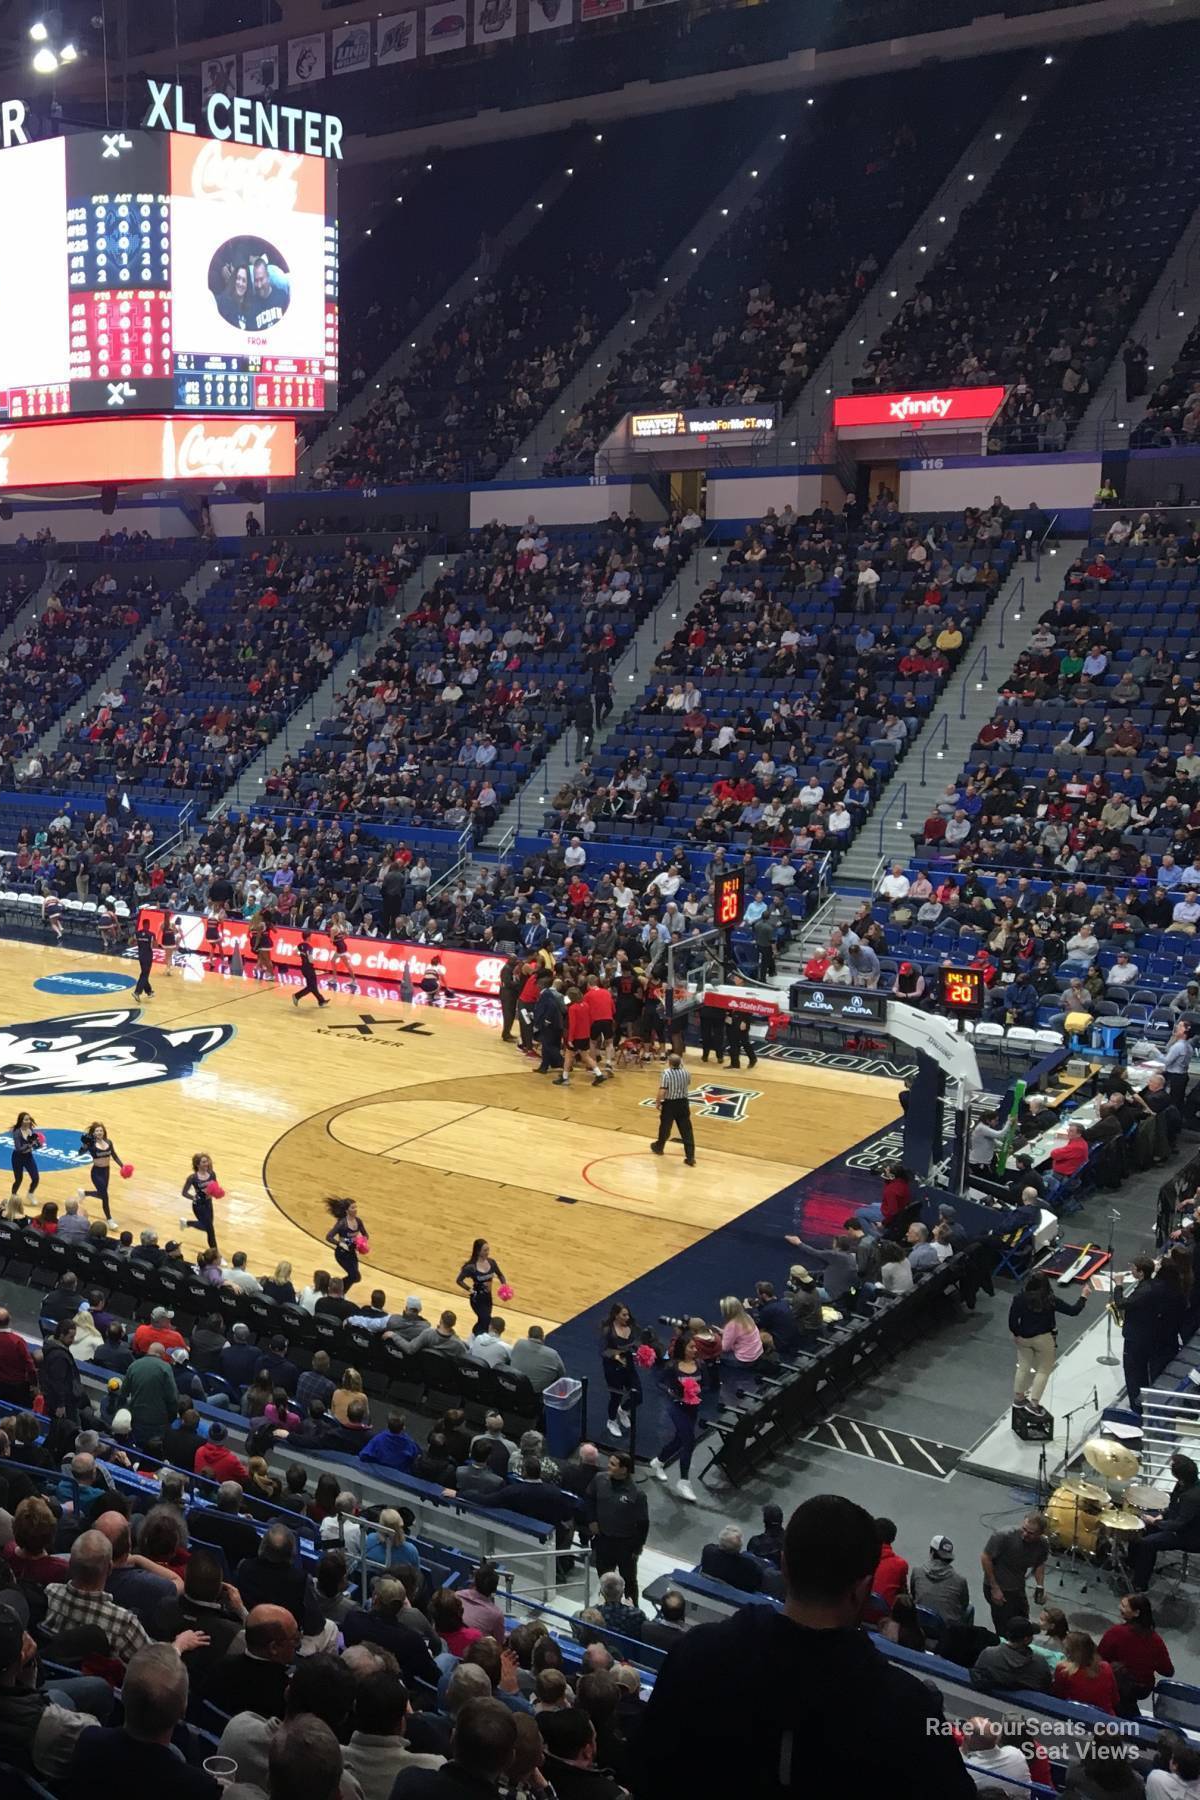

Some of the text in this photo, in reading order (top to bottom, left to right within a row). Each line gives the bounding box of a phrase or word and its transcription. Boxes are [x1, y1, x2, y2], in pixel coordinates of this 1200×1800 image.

[147, 80, 344, 159] XL CENTER
[102, 133, 132, 158] XL
[92, 194, 109, 204] PTS
[114, 193, 132, 203] AST
[95, 206, 106, 218] 0
[118, 205, 129, 217] 0
[140, 204, 150, 217] 0
[160, 205, 169, 217] 0
[118, 220, 129, 233] 0
[140, 220, 151, 232] 0
[160, 221, 169, 233] 0
[96, 238, 107, 250] 0
[118, 236, 129, 249] 0
[160, 237, 169, 249] 0
[96, 253, 107, 266] 0
[161, 253, 169, 265] 0
[119, 268, 130, 281] 0
[141, 268, 151, 281] 0
[119, 301, 130, 313] 0
[119, 316, 131, 329] 0
[161, 316, 170, 328] 0
[161, 332, 170, 344] 0
[162, 348, 170, 360] 0
[121, 364, 131, 376] 0
[142, 363, 153, 376] 0
[107, 382, 137, 406] XL
[889, 396, 952, 420] xfinity
[635, 419, 677, 431] WATCH
[920, 457, 944, 469] 116
[589, 475, 607, 485] 115
[362, 488, 377, 498] 114
[721, 893, 738, 922] 20
[947, 972, 979, 985] 14:11
[951, 986, 972, 1003] 20
[803, 1001, 834, 1011] ACURA
[841, 1005, 873, 1016] ACURA
[334, 1031, 404, 1048] CENTER
